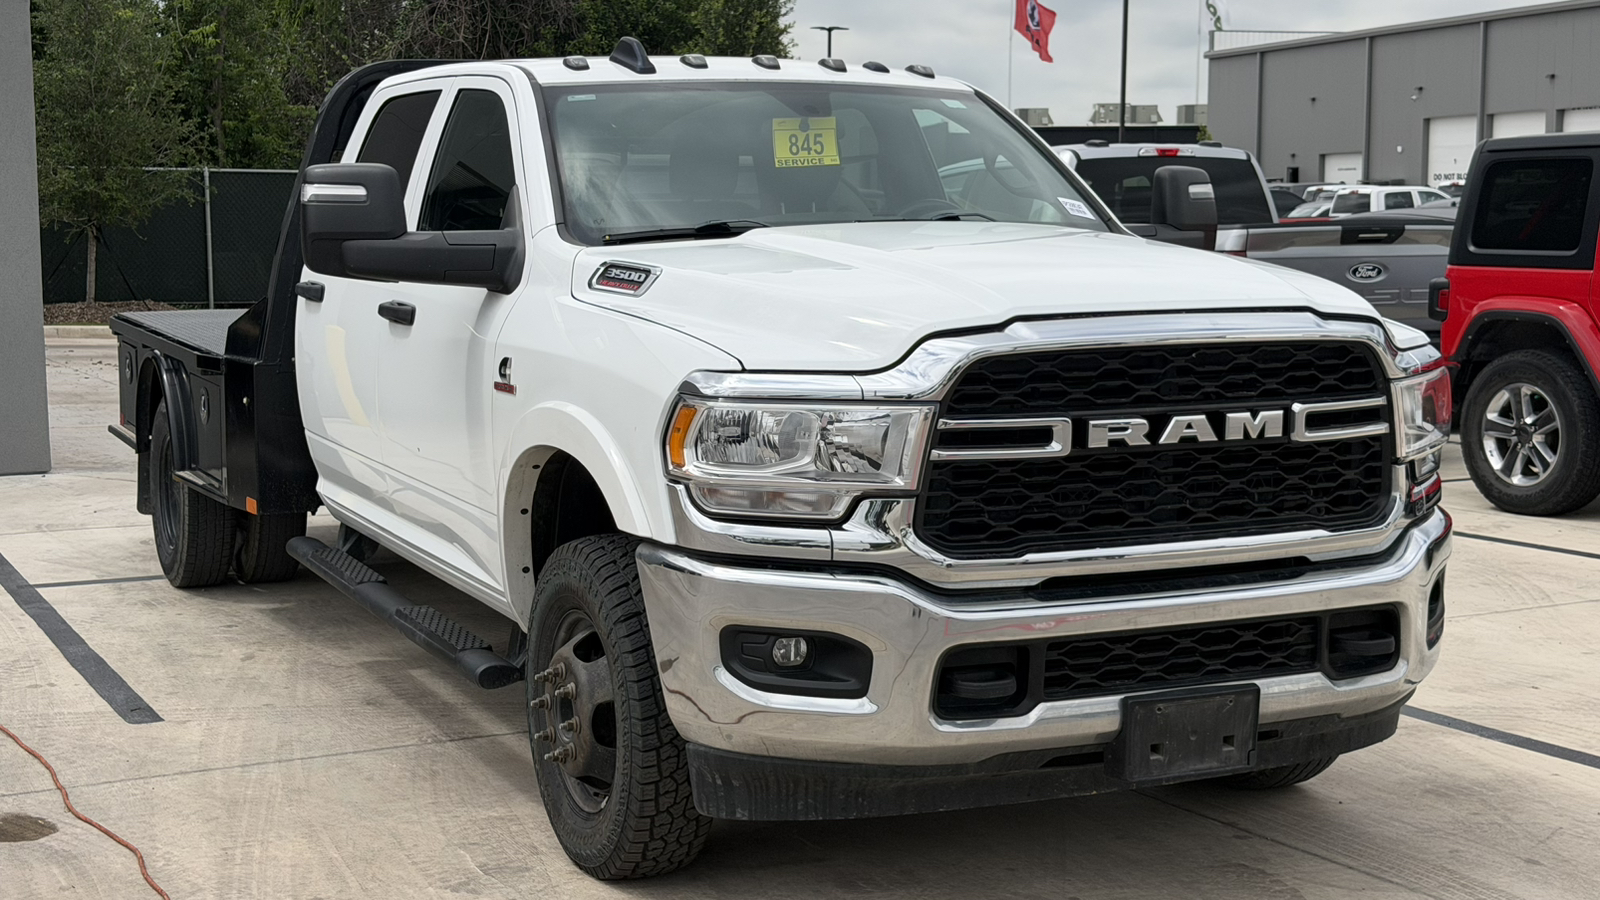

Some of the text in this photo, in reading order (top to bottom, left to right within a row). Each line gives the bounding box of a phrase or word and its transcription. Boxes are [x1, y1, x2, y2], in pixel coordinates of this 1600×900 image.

[788, 133, 825, 156] 845
[777, 158, 825, 167] SERVICE
[1433, 173, 1442, 181] DO
[1456, 172, 1468, 180] BLO
[605, 268, 646, 282] 3500
[1355, 266, 1379, 278] Ford
[1088, 410, 1284, 448] RAM
